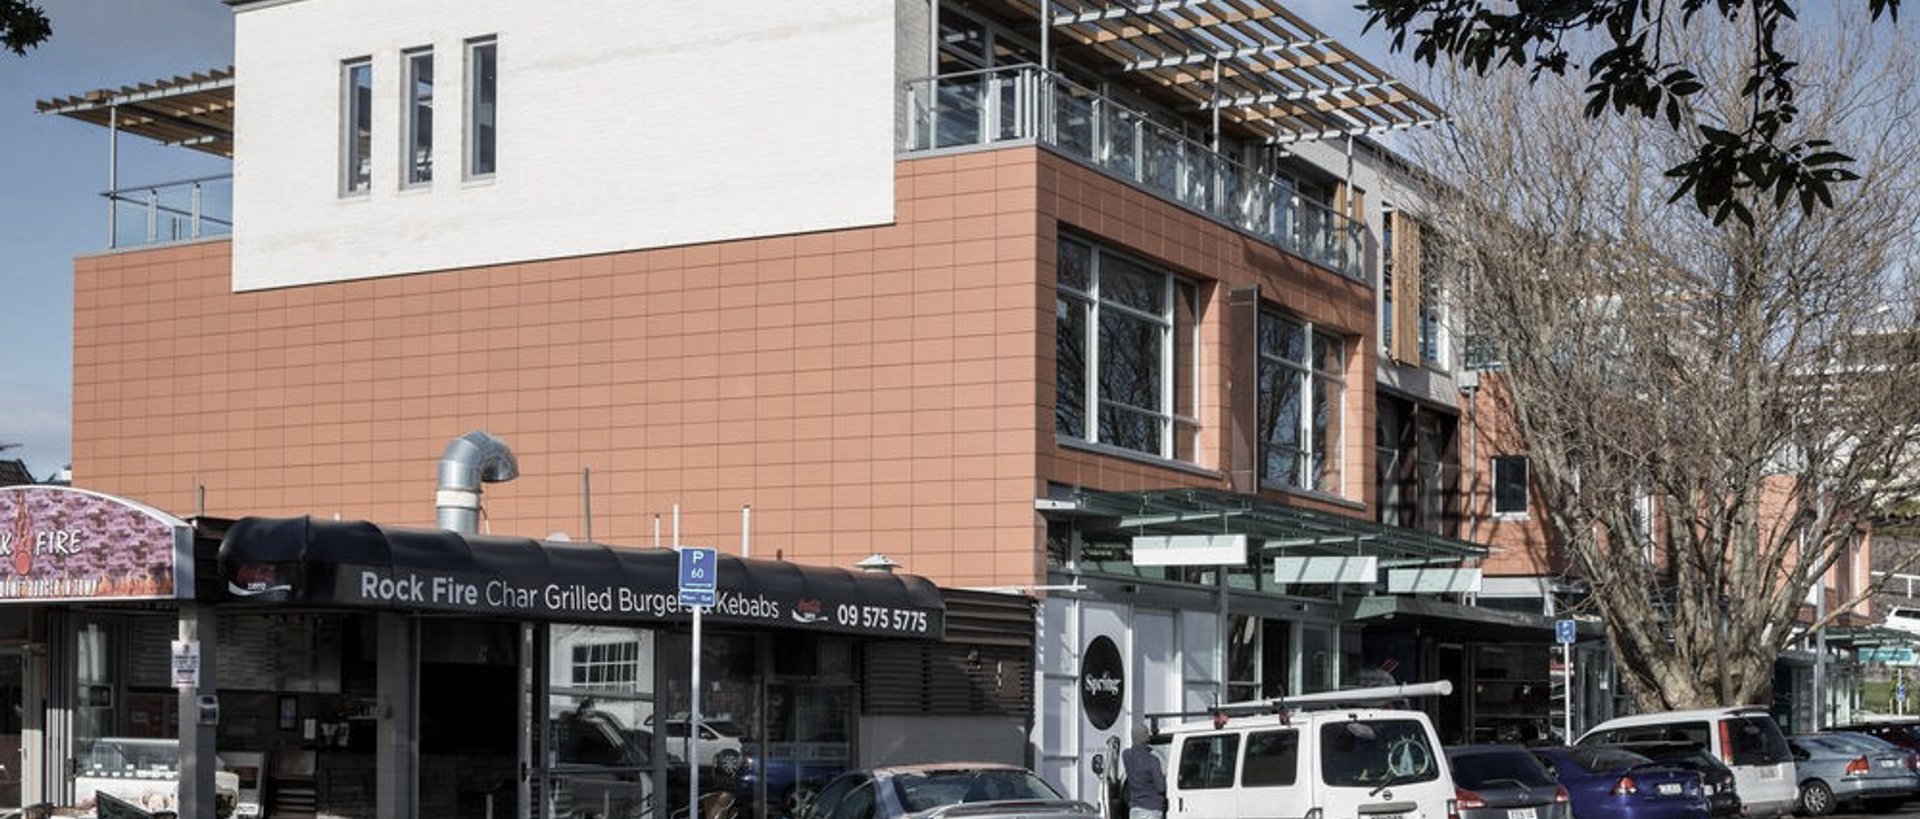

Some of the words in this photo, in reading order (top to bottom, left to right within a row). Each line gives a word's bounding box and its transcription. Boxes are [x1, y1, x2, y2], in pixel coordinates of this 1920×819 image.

[36, 529, 82, 556] FIRE
[692, 550, 704, 564] P
[691, 567, 704, 579] 60
[361, 571, 424, 602] Rock
[432, 577, 478, 605] Fire
[485, 580, 538, 608] Char
[544, 584, 612, 611] Grilled
[618, 586, 693, 617] Burge
[717, 590, 780, 619] Kebabs
[837, 604, 859, 626] 09
[863, 606, 889, 629] 575
[893, 608, 927, 633] 5775
[1084, 671, 1121, 696] Spring
